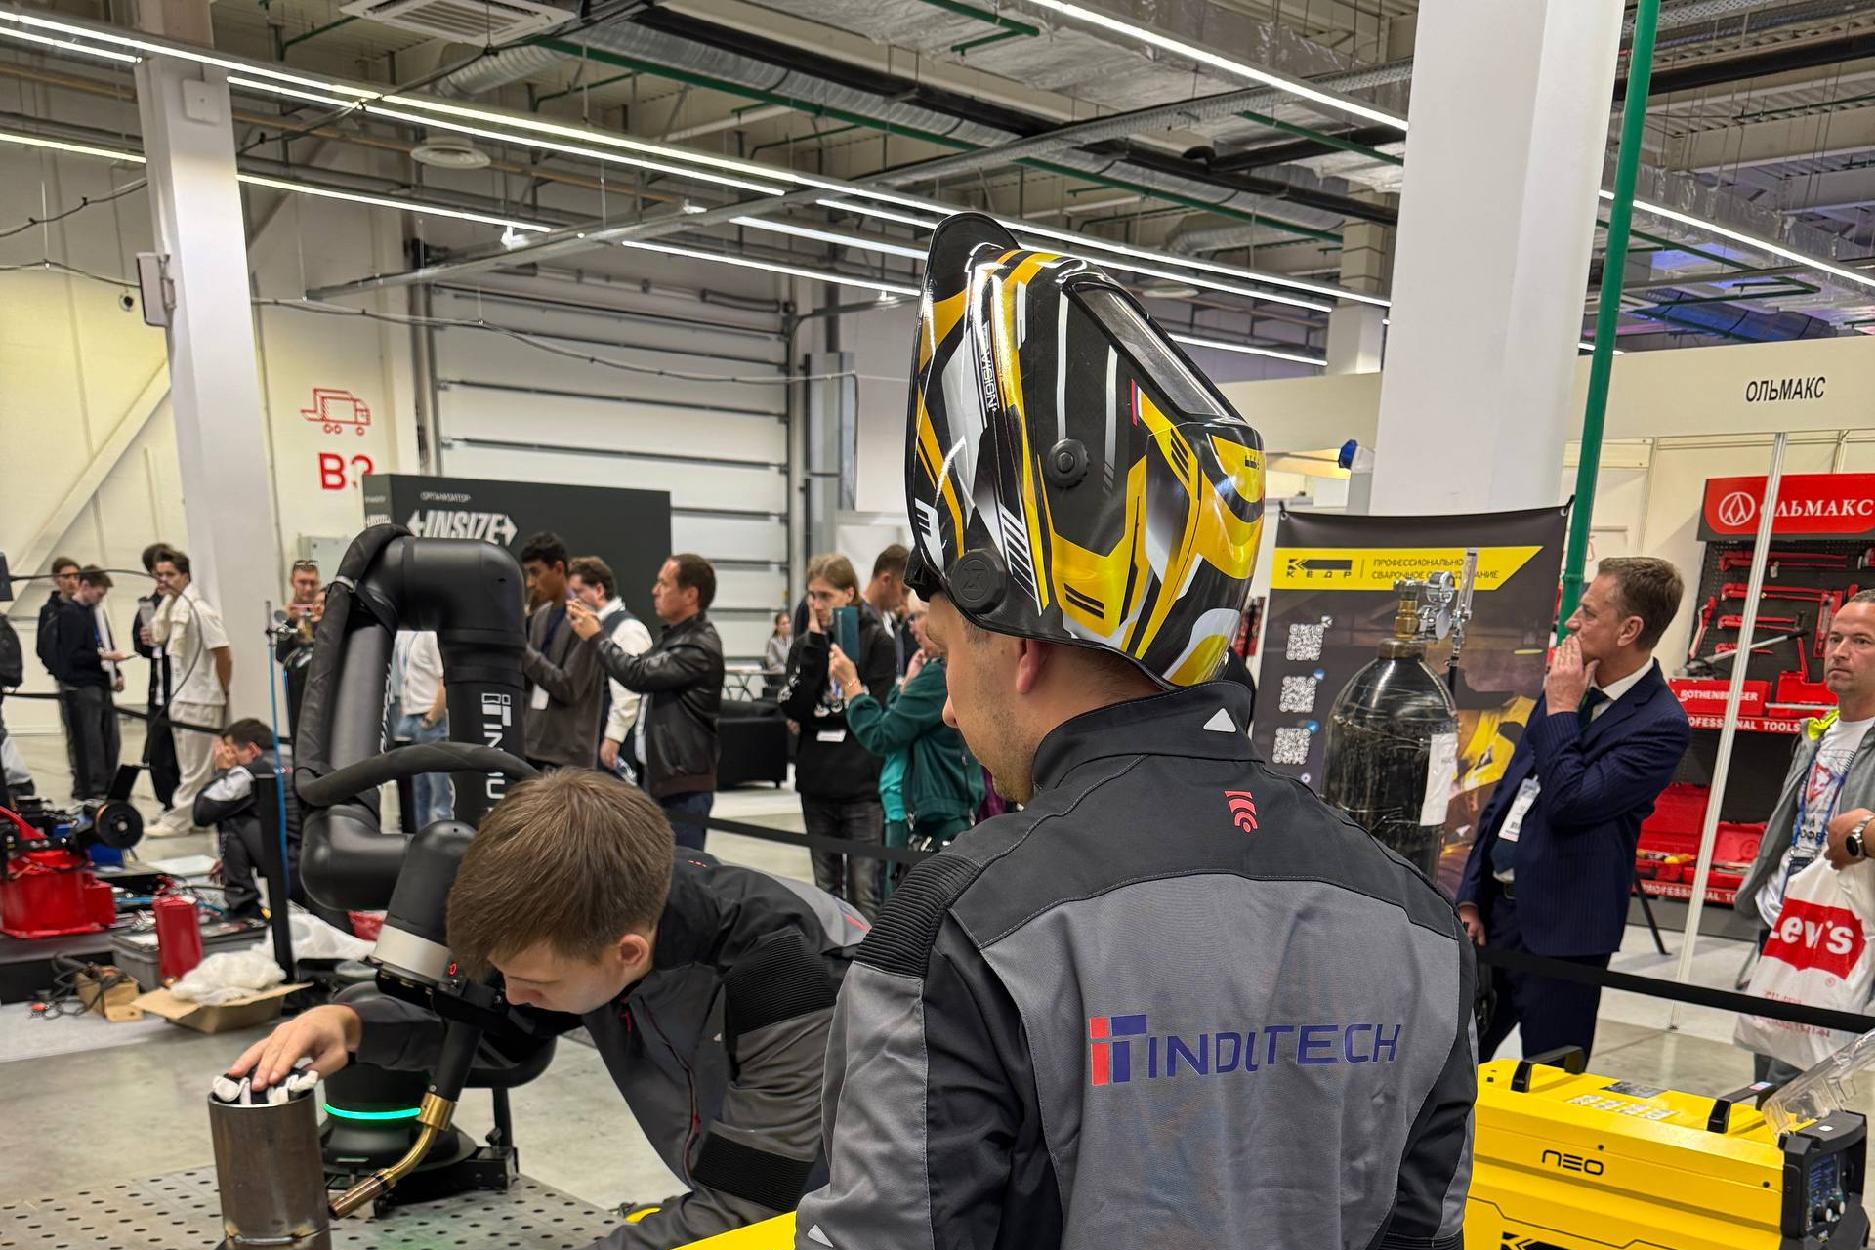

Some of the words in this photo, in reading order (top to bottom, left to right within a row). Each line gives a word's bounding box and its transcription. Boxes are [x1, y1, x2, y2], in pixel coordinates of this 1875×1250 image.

[1746, 377, 1826, 402] ОЛЬМАКС
[1760, 499, 1875, 518] ЛЬМАКС
[1287, 571, 1352, 579] КЕДР
[1763, 721, 1801, 732] TOOLS
